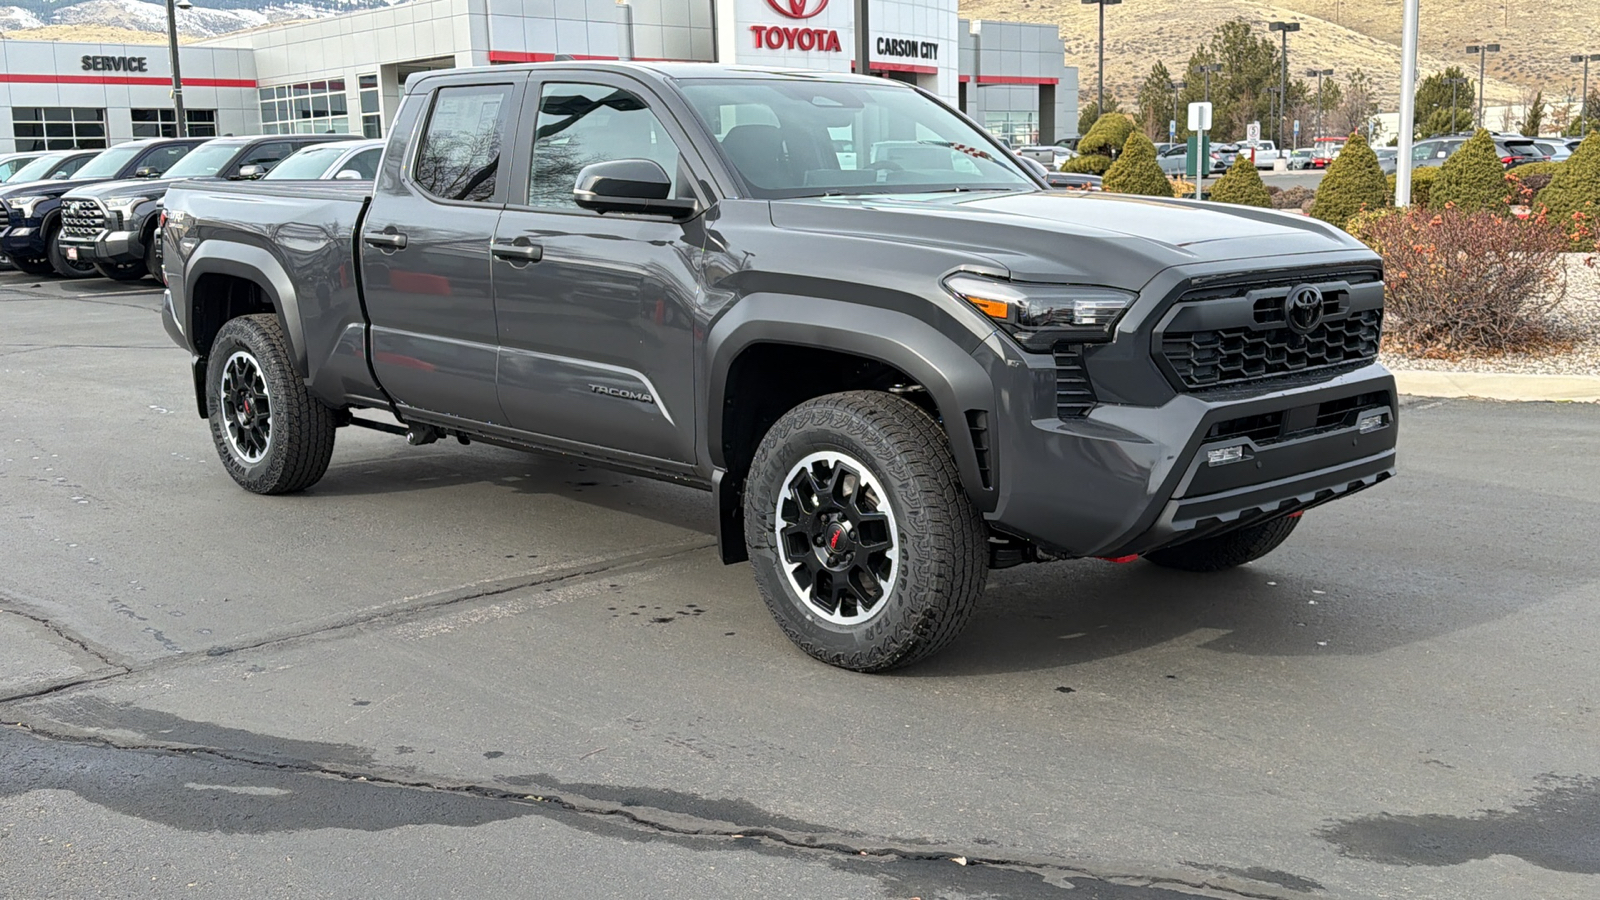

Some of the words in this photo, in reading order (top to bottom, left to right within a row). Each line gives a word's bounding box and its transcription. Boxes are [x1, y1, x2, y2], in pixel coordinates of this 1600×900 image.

[751, 25, 842, 52] TOYOTA
[877, 37, 918, 58] CARSON
[920, 40, 939, 60] CITY
[81, 55, 148, 72] SERVICE
[588, 383, 654, 404] TACOMA
